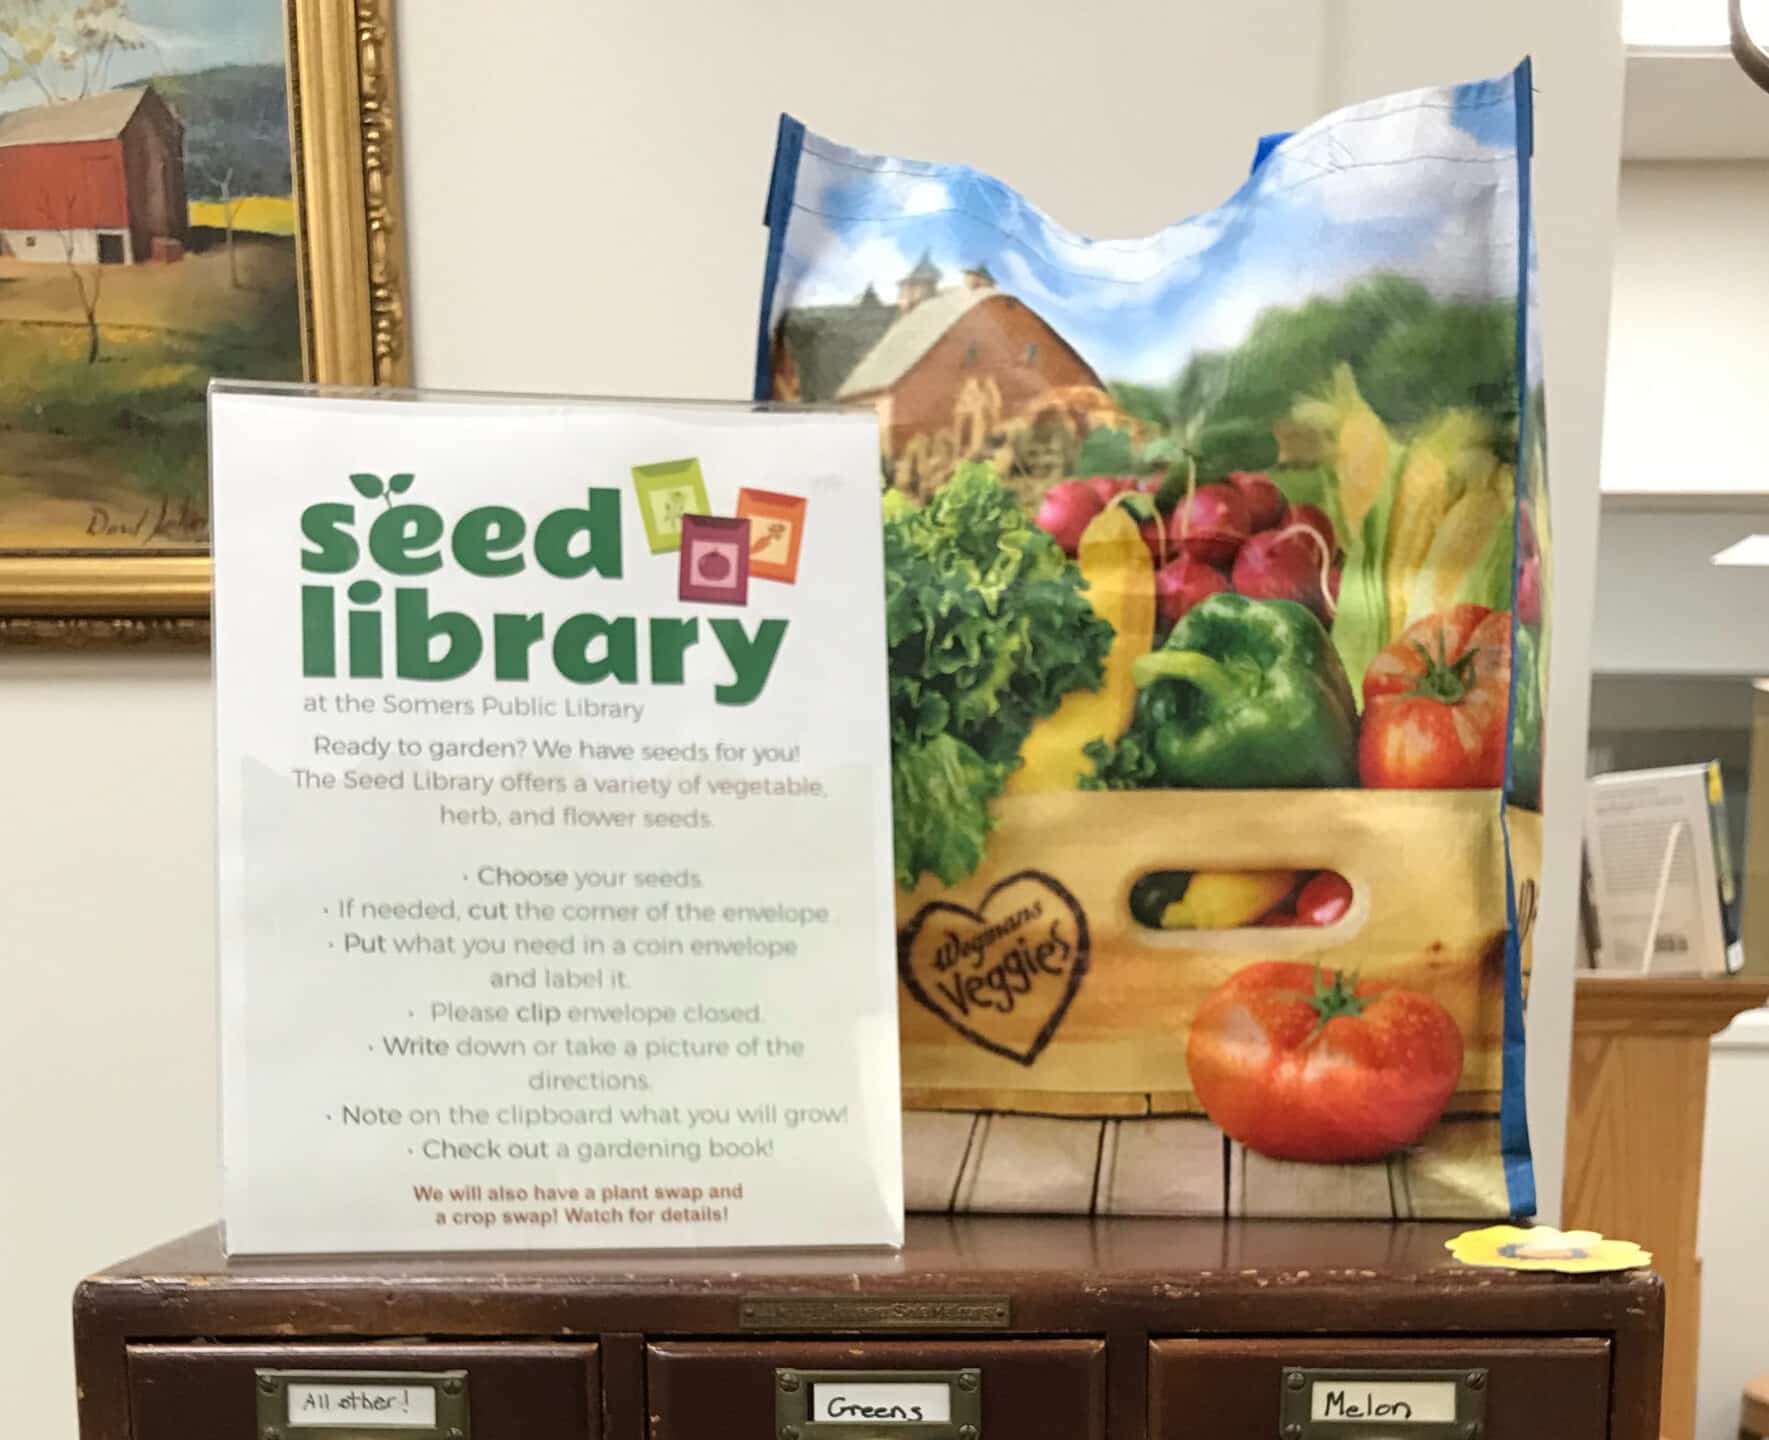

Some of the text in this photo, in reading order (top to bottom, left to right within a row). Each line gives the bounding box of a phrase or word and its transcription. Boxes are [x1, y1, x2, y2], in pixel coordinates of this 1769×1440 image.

[300, 486, 624, 580] seed
[301, 580, 790, 707] library
[304, 693, 645, 723] at the Somers Public Library
[314, 735, 800, 766] Ready to garden? We have seeds for you!
[292, 769, 337, 789] The
[343, 769, 404, 790] Seed
[413, 770, 494, 796] Library
[500, 772, 567, 793] offers
[574, 778, 588, 793] a
[594, 776, 672, 799] variety
[678, 775, 701, 795] of
[440, 804, 502, 827] herb,
[509, 806, 555, 826] and
[563, 806, 635, 828] flower
[477, 865, 568, 887] Choose
[574, 871, 627, 891] your
[338, 897, 354, 919] If
[361, 899, 462, 922] needed,
[468, 902, 508, 921] cut
[515, 900, 555, 921] the
[562, 903, 638, 922] corner
[646, 902, 668, 922] of
[676, 902, 715, 923] the
[344, 932, 798, 959] Put what you need in a coin envelope
[490, 968, 536, 989] and
[544, 968, 603, 989] label
[936, 918, 1070, 1016] Veggies
[431, 1001, 509, 1023] Please
[516, 1002, 561, 1026] clip
[568, 1001, 676, 1026] envelope
[383, 1036, 805, 1060] Write down or take a picture of the
[342, 1104, 848, 1128] Note on the clipboard what you will grow!
[422, 1137, 774, 1164] Check out a gardening book!
[413, 1183, 744, 1203] We will also have a plant swap and
[436, 1206, 729, 1228] a crop swap! Watch for details!
[304, 1392, 329, 1411] All
[827, 1397, 923, 1421] Greens
[1324, 1390, 1412, 1419] Melon
